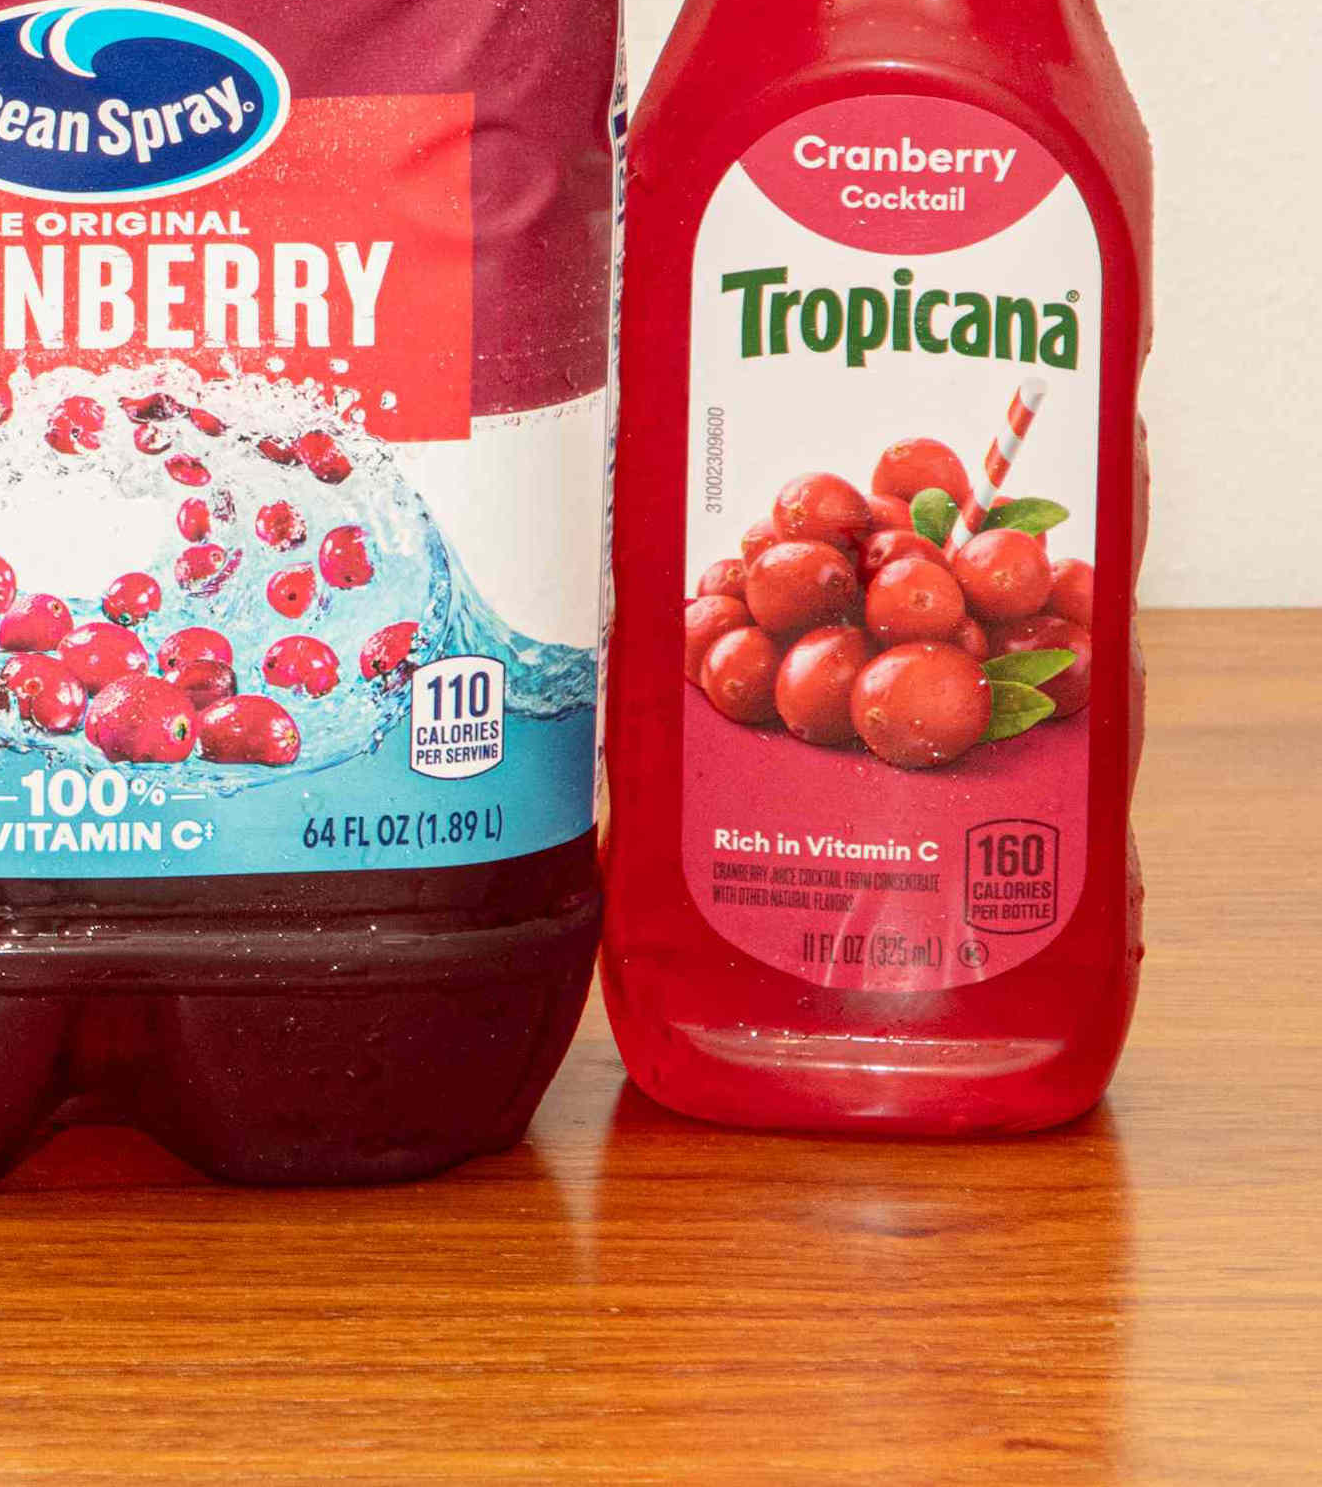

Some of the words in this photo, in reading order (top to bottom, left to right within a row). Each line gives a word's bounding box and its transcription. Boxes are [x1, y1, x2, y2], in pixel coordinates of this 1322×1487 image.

[97, 75, 245, 164] Spray
[793, 135, 1017, 182] Cranberry
[840, 185, 966, 212] Cocktail
[35, 210, 251, 237] ORIGINAL
[721, 265, 1080, 371] Tropicana
[705, 406, 725, 514] 31002309600
[426, 671, 490, 721] 110
[416, 721, 500, 746] CALORIES
[416, 748, 442, 766] PER
[445, 744, 499, 763] SERVING
[20, 768, 166, 818] 100%
[303, 818, 337, 849] 64
[344, 816, 370, 847] FL
[377, 814, 410, 845] OZ
[417, 811, 478, 850] (1.89
[485, 804, 503, 842] L)
[713, 828, 771, 854] Rich
[777, 832, 800, 856] in
[806, 835, 912, 862] Vitamin
[917, 840, 940, 863] C
[977, 833, 1045, 878] 160
[972, 880, 1053, 901] CALORIES
[972, 904, 999, 922] PER
[1000, 902, 1051, 921] BOTTLE
